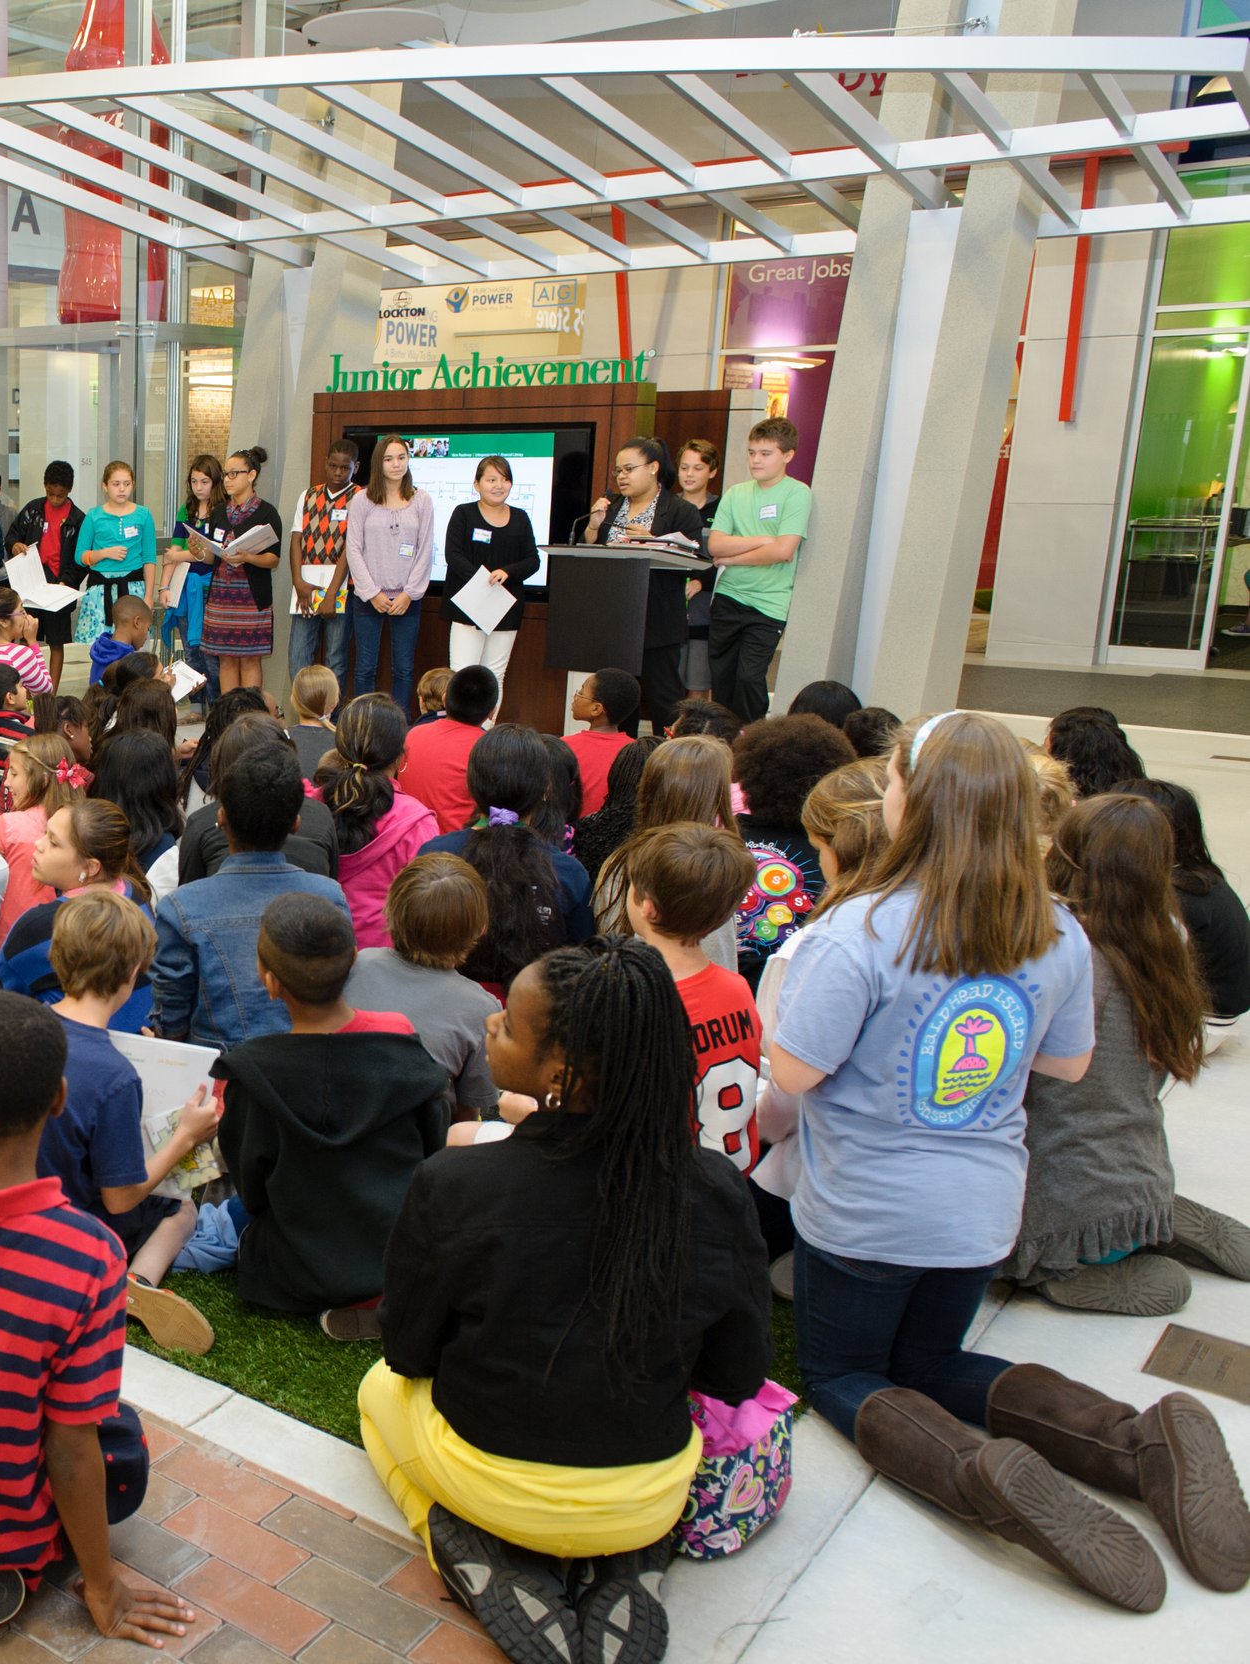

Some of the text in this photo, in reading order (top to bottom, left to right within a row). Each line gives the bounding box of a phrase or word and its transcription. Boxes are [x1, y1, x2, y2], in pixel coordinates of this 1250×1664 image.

[749, 259, 850, 284] Great Jobs
[472, 293, 513, 306] POWER
[537, 285, 571, 302] AIG
[379, 308, 426, 319] LOCKTON
[386, 320, 437, 347] POWER
[326, 350, 649, 393] Junior Achievement
